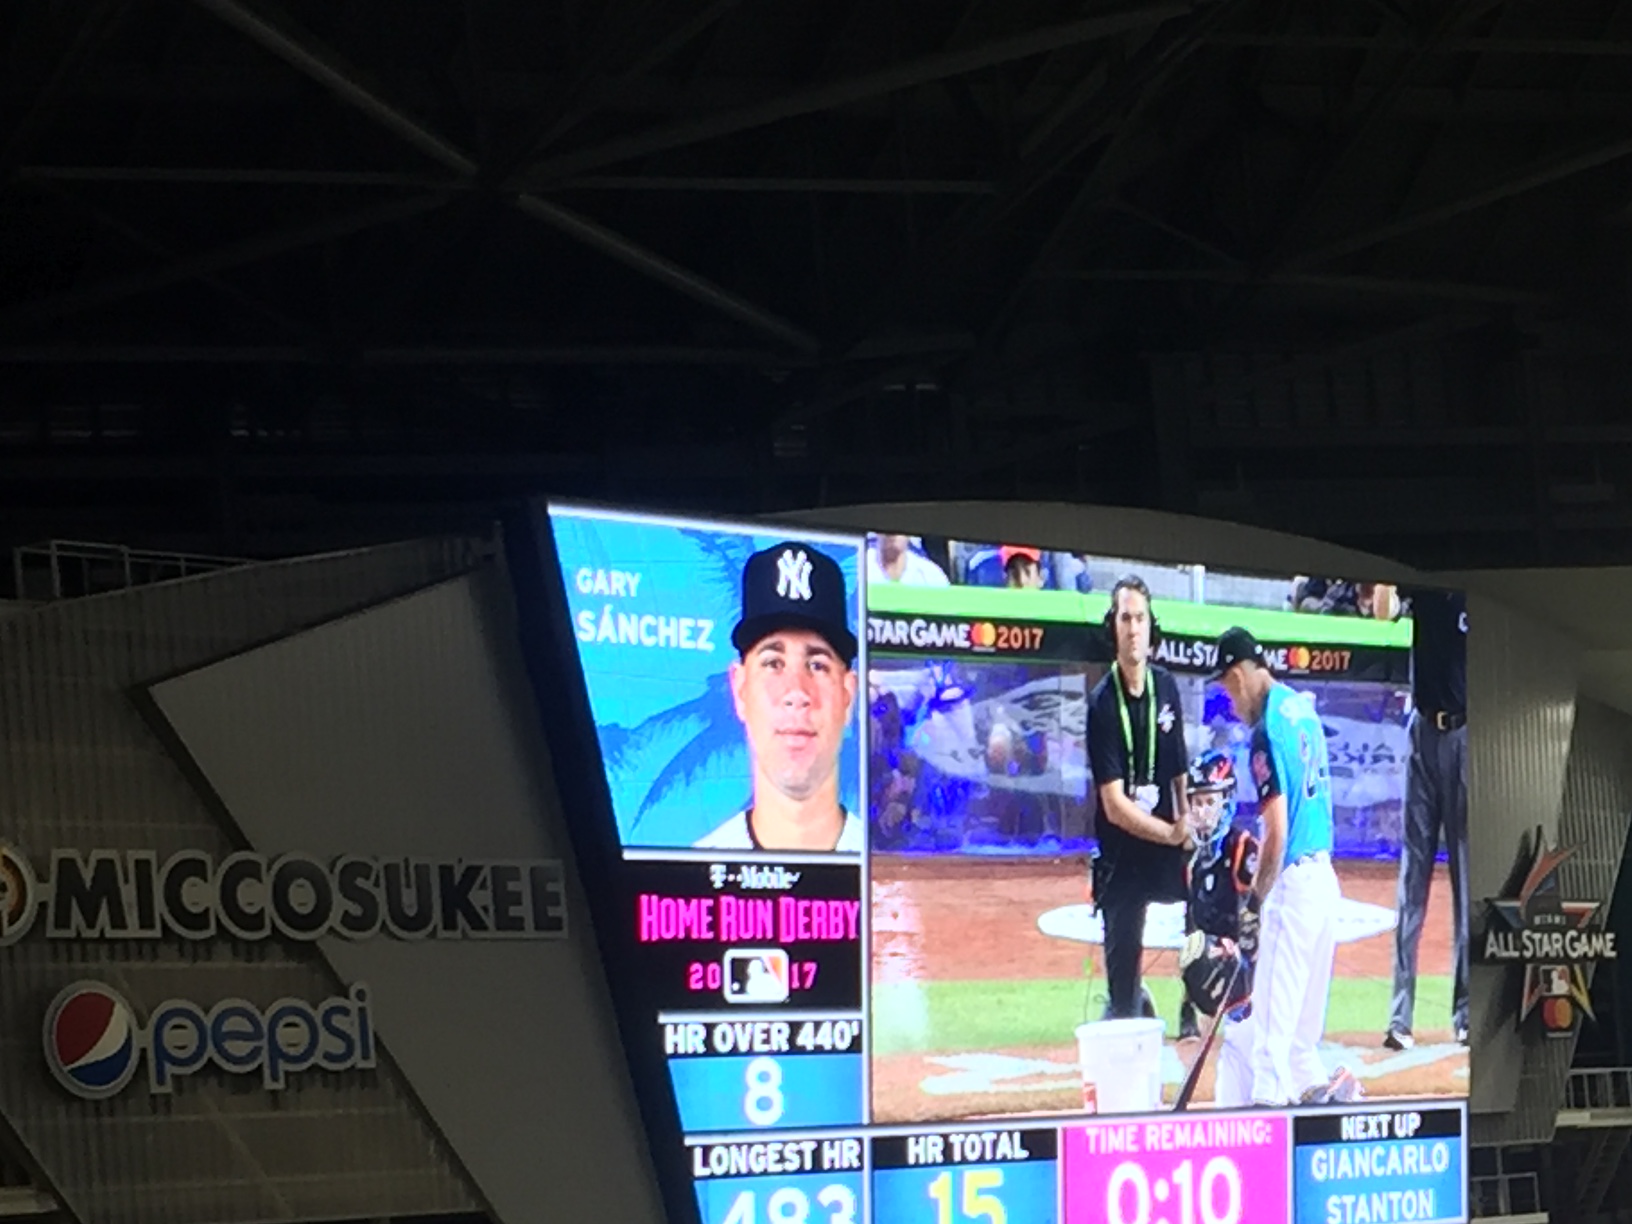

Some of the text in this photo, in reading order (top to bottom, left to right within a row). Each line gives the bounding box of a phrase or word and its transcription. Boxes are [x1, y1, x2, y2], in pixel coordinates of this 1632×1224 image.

[576, 567, 642, 598] GARY
[577, 604, 716, 652] SÁNCHEZ
[997, 626, 1043, 650] 2017
[1311, 650, 1350, 671] 2017
[50, 850, 568, 938] MICCOSUKEE
[639, 894, 860, 943] HOME RUN DERBY
[687, 961, 818, 990] 20 17
[151, 983, 375, 1093] pepsi
[664, 1022, 707, 1054] HR
[713, 1021, 789, 1053] OVER
[743, 1055, 785, 1127] 8
[1086, 1119, 1273, 1154] TIME REMAINING:
[1339, 1111, 1422, 1141] NEXT UP
[693, 1138, 861, 1177] LONGEST HR
[907, 1131, 1029, 1166] HR TOTAL
[1311, 1142, 1449, 1181] GIANCARLO
